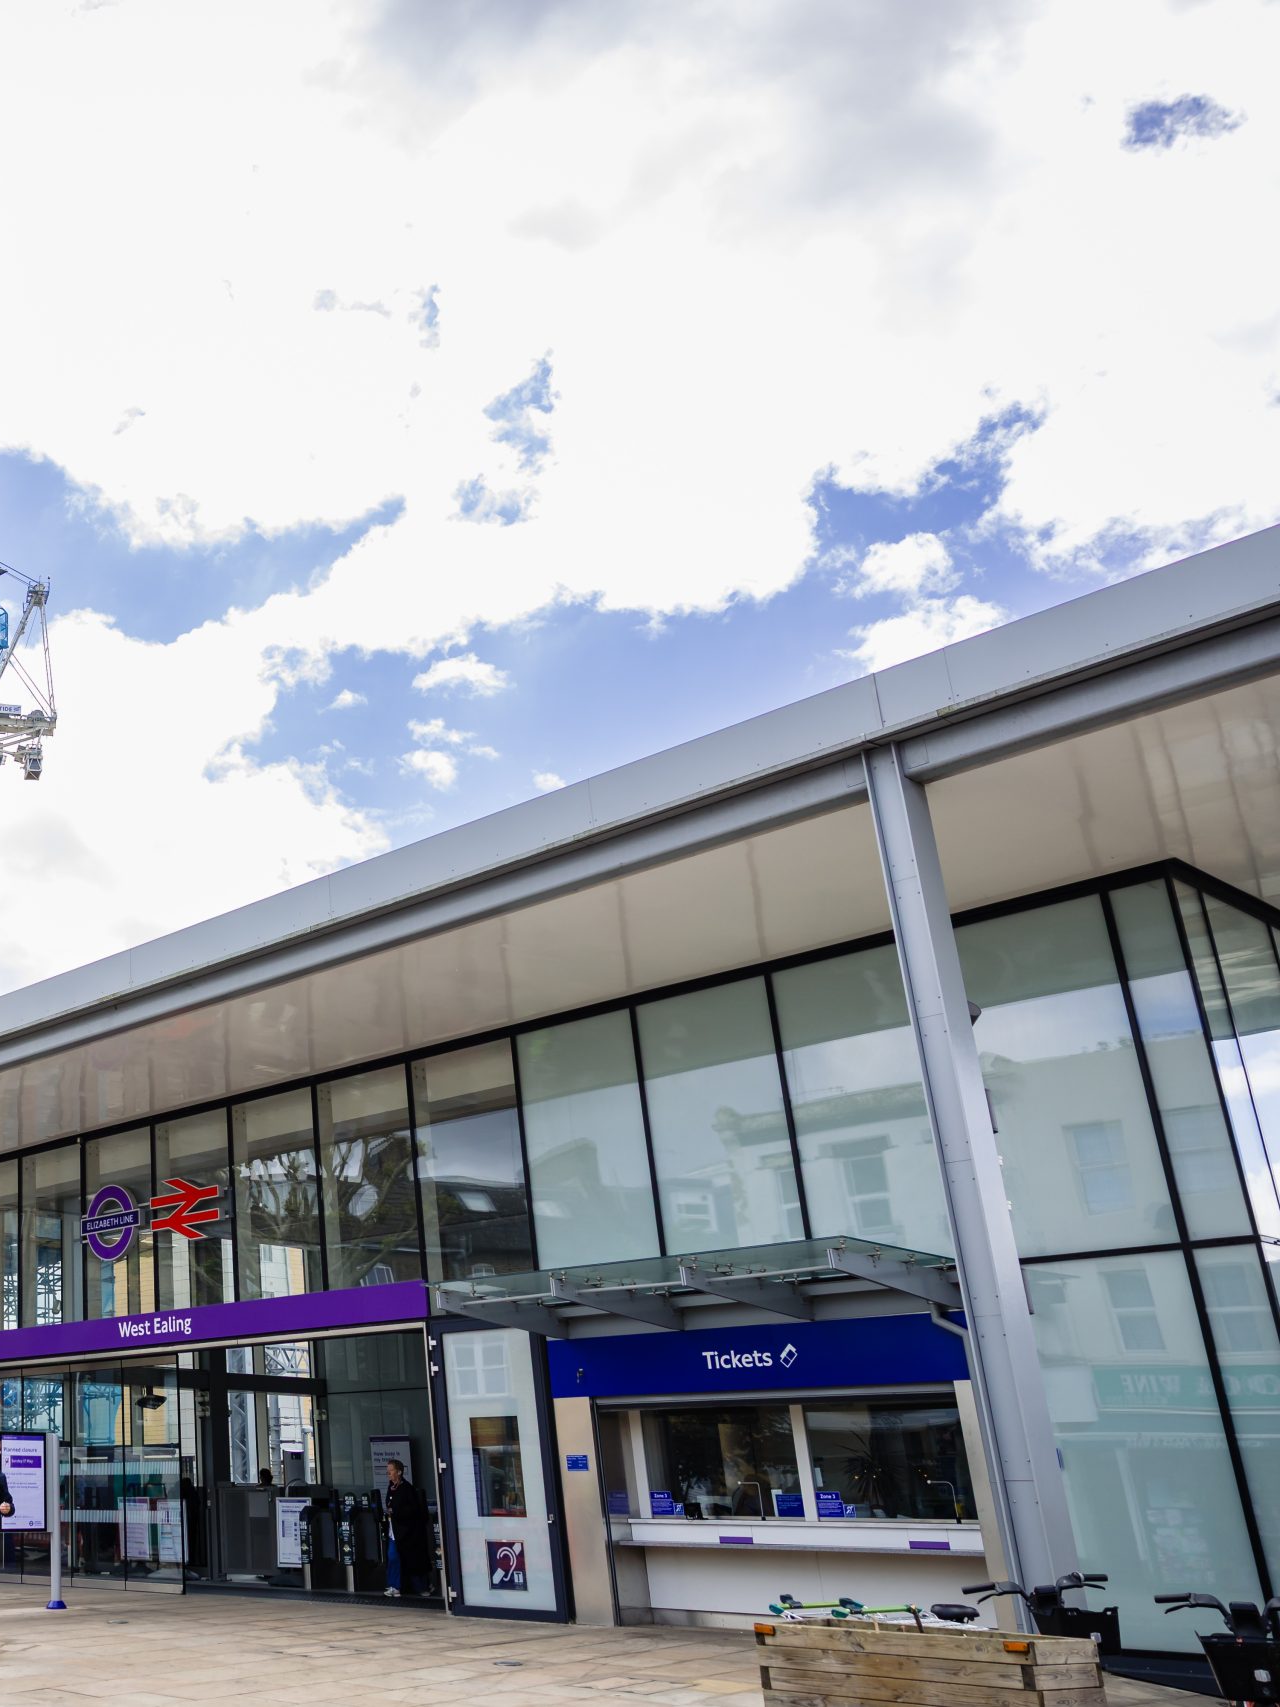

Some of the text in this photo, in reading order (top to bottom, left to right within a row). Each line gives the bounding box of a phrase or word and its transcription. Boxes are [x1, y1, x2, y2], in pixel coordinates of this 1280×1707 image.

[86, 1214, 134, 1231] ELIZABETH LINE
[118, 1316, 192, 1338] West Ealing
[702, 1350, 773, 1370] Tickets
